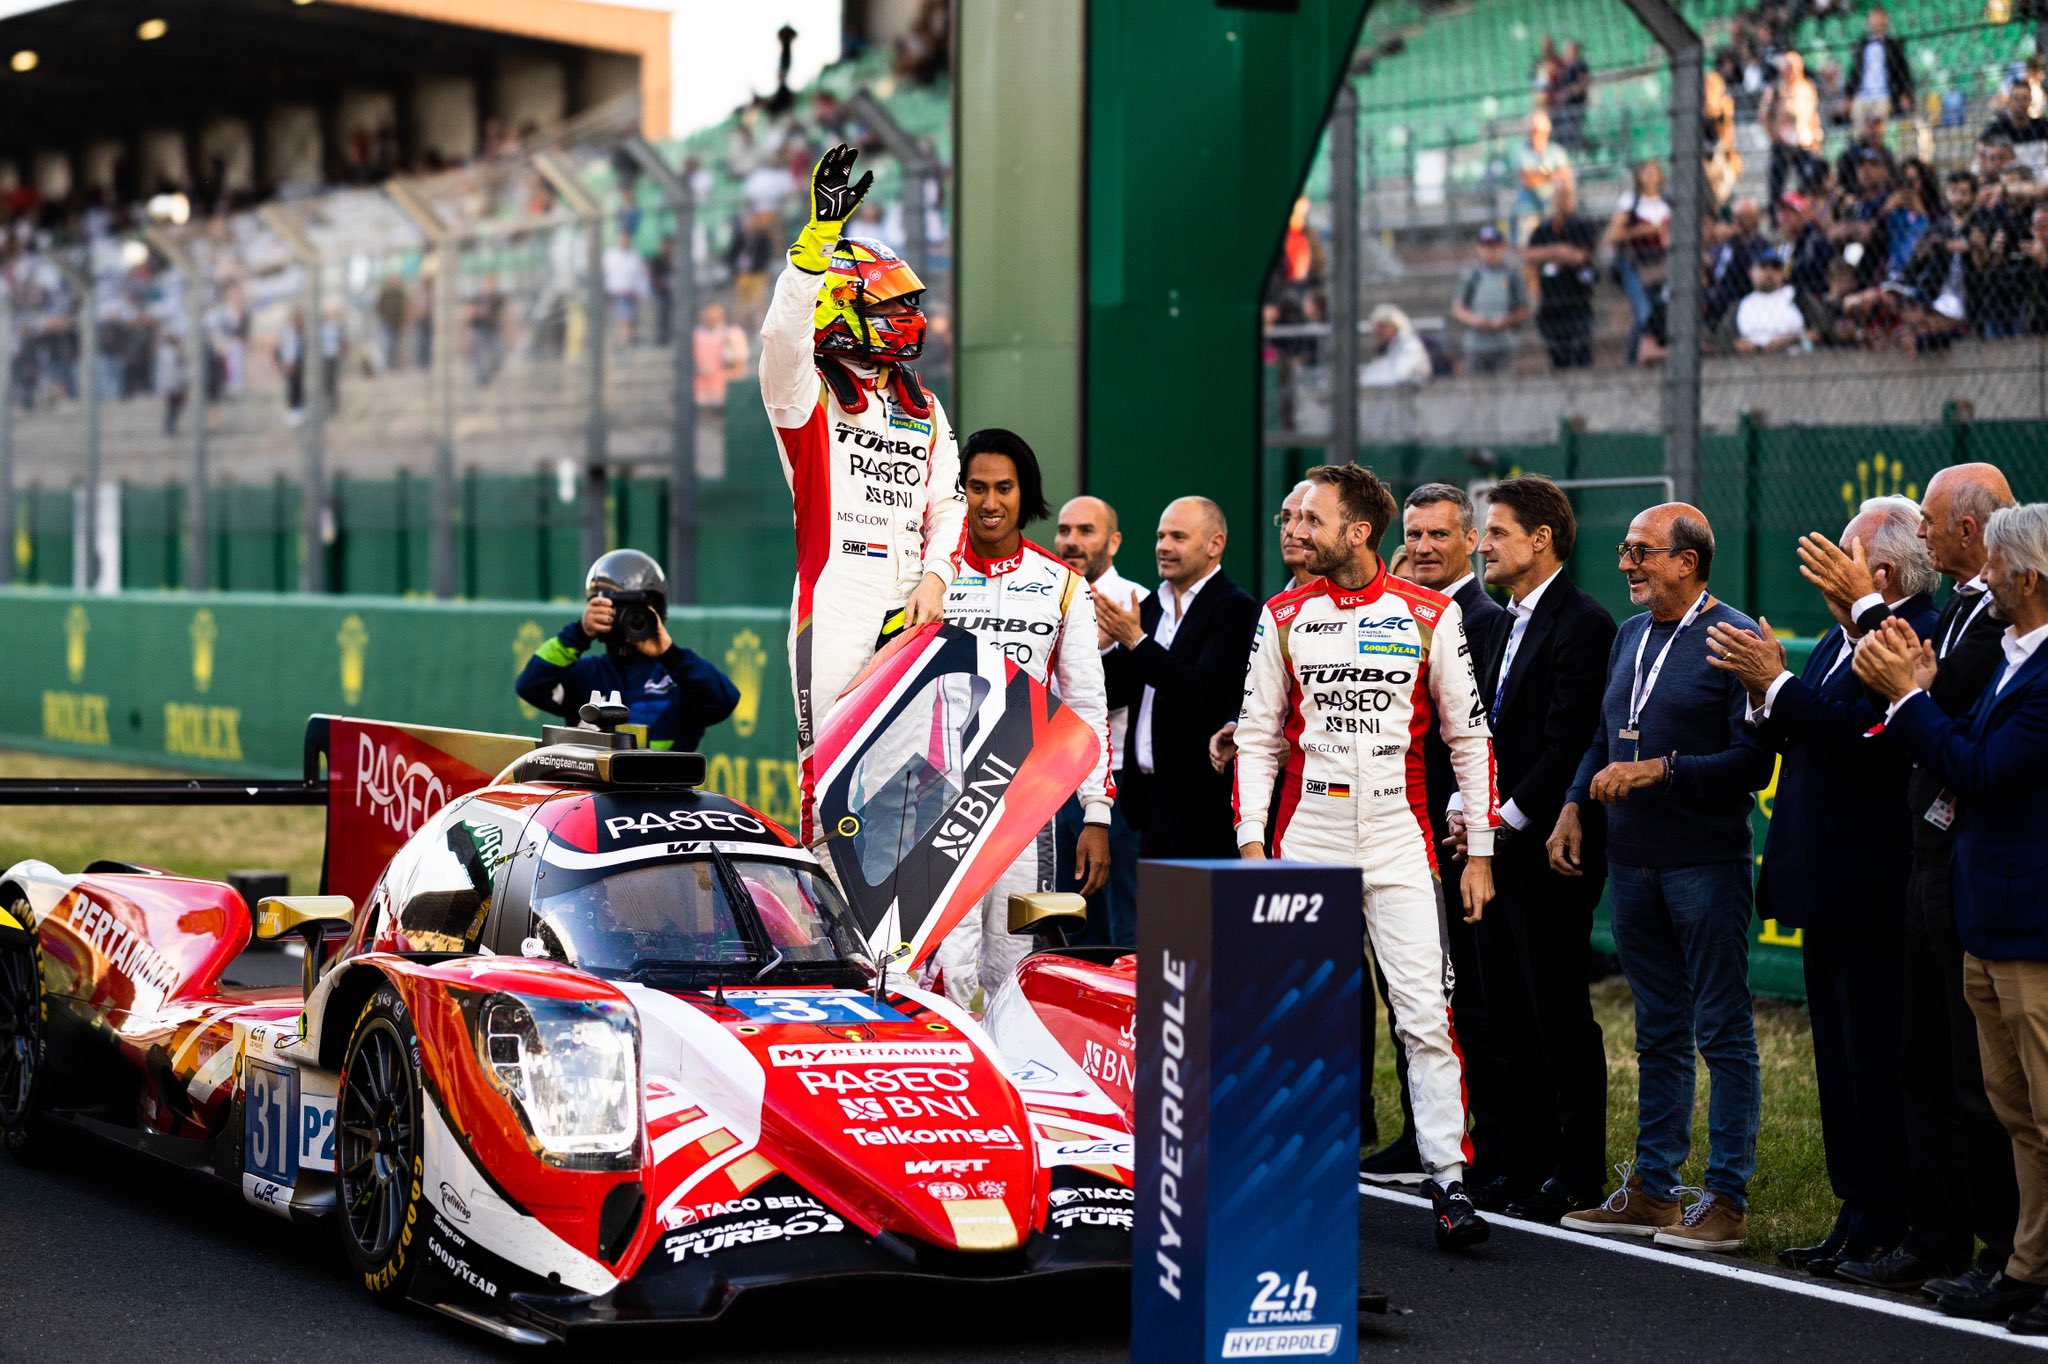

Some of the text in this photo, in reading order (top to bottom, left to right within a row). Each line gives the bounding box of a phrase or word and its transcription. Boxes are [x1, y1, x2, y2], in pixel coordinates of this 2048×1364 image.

[835, 428, 927, 461] TURBO
[850, 453, 920, 486] PASEO
[883, 490, 913, 509] BNI
[837, 511, 889, 526] MS GLOW
[842, 541, 867, 554] OMP
[990, 555, 1020, 576] KFC
[1007, 580, 1054, 596] WEC
[1340, 594, 1365, 606] KFC
[1275, 605, 1296, 619] OMP
[1414, 604, 1437, 620] OMP
[1304, 621, 1348, 634] WRT
[1358, 616, 1414, 630] WEC
[1363, 643, 1417, 655] GOODYEAR
[1300, 662, 1351, 671] PERTAMAX
[1300, 668, 1412, 686] TURBO
[1313, 688, 1392, 712] PASEO
[42, 690, 110, 745] ROLEX
[1346, 718, 1380, 734] BNI
[1468, 717, 1482, 728] LE
[165, 702, 242, 760] ROLEX
[1303, 743, 1350, 754] MS GLOW
[526, 754, 594, 772] w-racingteam.com
[356, 731, 446, 840] PASEO
[698, 752, 801, 826] OLEX
[953, 752, 1017, 823] BNI
[1306, 781, 1327, 793] OMP
[1374, 787, 1404, 797] R. RAST
[604, 810, 766, 840] PASEO
[259, 911, 281, 925] WRT
[1251, 893, 1324, 924] LMP2
[67, 892, 181, 998] PERTAMINA
[755, 997, 885, 1021] 31
[796, 1067, 970, 1096] PASEO
[1102, 1050, 1136, 1093] BN
[884, 1095, 980, 1118] BNI
[252, 1069, 288, 1174] 31
[1156, 949, 1187, 1301] HYPERPOLE
[303, 1104, 336, 1161] P2
[843, 1124, 1021, 1146] Telkomsel
[1057, 1143, 1131, 1155] WEC
[904, 1159, 990, 1174] WRT
[929, 1184, 966, 1198] FIA
[1077, 1187, 1135, 1201] TACO
[441, 1187, 471, 1219] GrafiWrap
[696, 1195, 824, 1219] TACO BELL
[1052, 1206, 1135, 1220] PERTAMA
[365, 1154, 424, 1293] GOODYEAR
[433, 1213, 466, 1248] Snap-on
[1055, 1213, 1135, 1228] TUR
[665, 1219, 770, 1249] PERTAMAX
[667, 1220, 821, 1263] TURBO
[428, 1236, 498, 1298] GOODYEAR
[1250, 1269, 1318, 1311] 24h
[1247, 1309, 1313, 1324] LE MANS
[1230, 1333, 1330, 1353] HYPERPOLE
